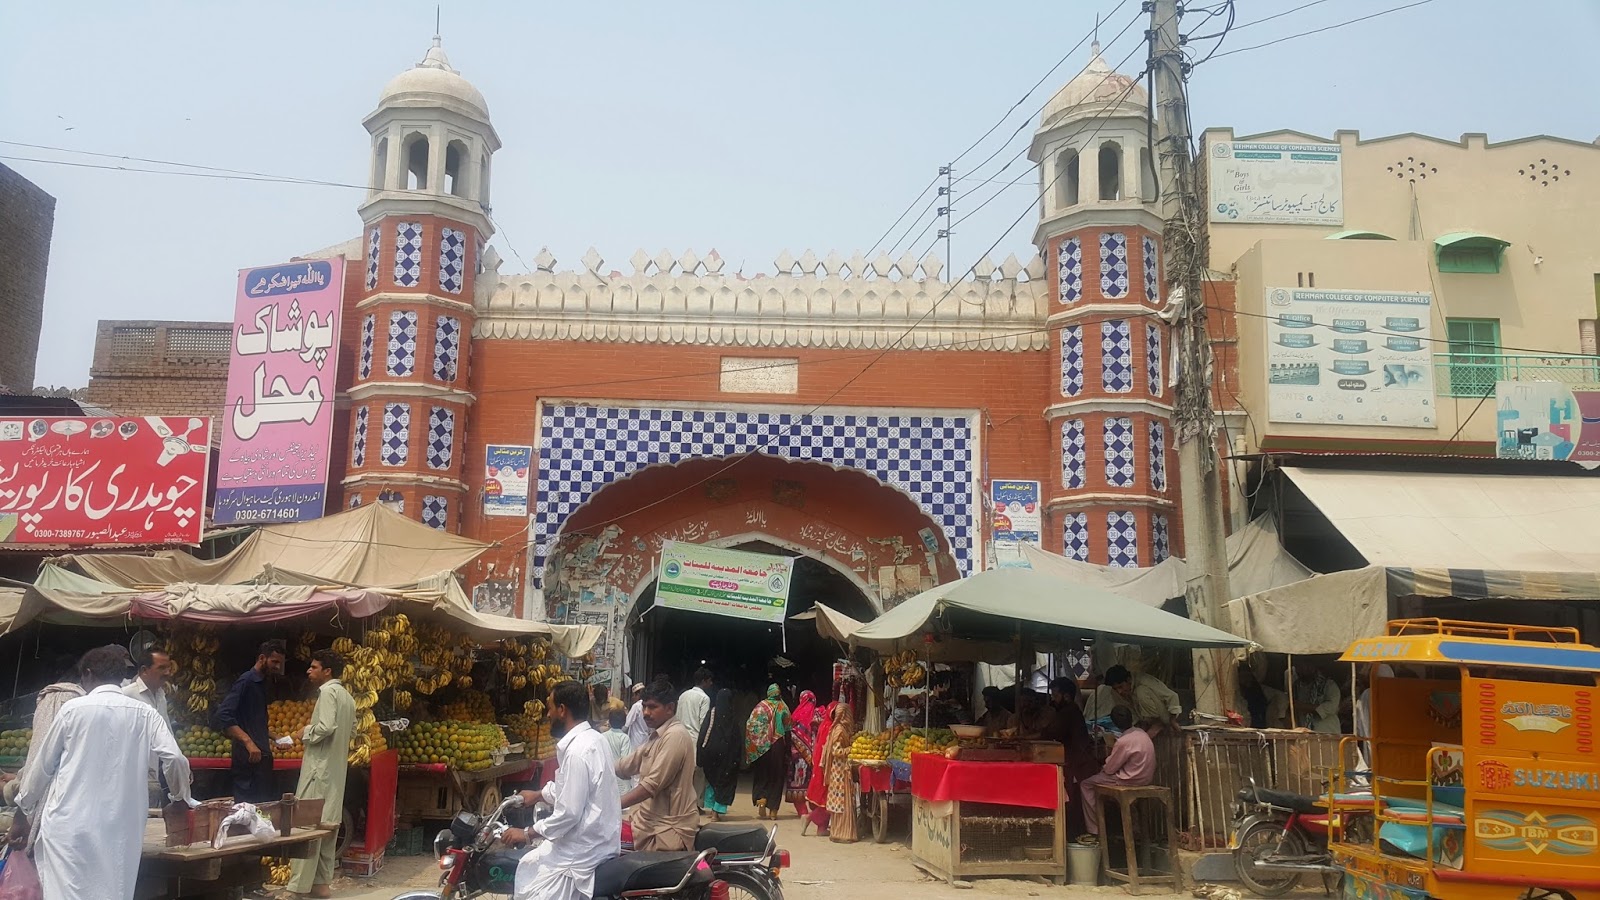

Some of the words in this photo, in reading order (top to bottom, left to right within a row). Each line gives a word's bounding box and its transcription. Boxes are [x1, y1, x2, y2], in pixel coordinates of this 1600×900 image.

[1234, 171, 1249, 179] Boys
[1295, 292, 1324, 300] REHMAN
[1325, 293, 1353, 301] COLLEGE
[1364, 294, 1399, 302] COMPUTER
[1400, 296, 1429, 304] SCIENCES
[236, 298, 334, 371] پوشاک
[233, 360, 324, 441] محل
[84, 463, 199, 531] چوہدری
[235, 508, 300, 520] 0302-6714601
[34, 529, 86, 539] 0300-7389767
[1352, 642, 1412, 657] SUZUKI
[1514, 767, 1600, 791] SUZUKI
[1519, 825, 1551, 839] TBM
